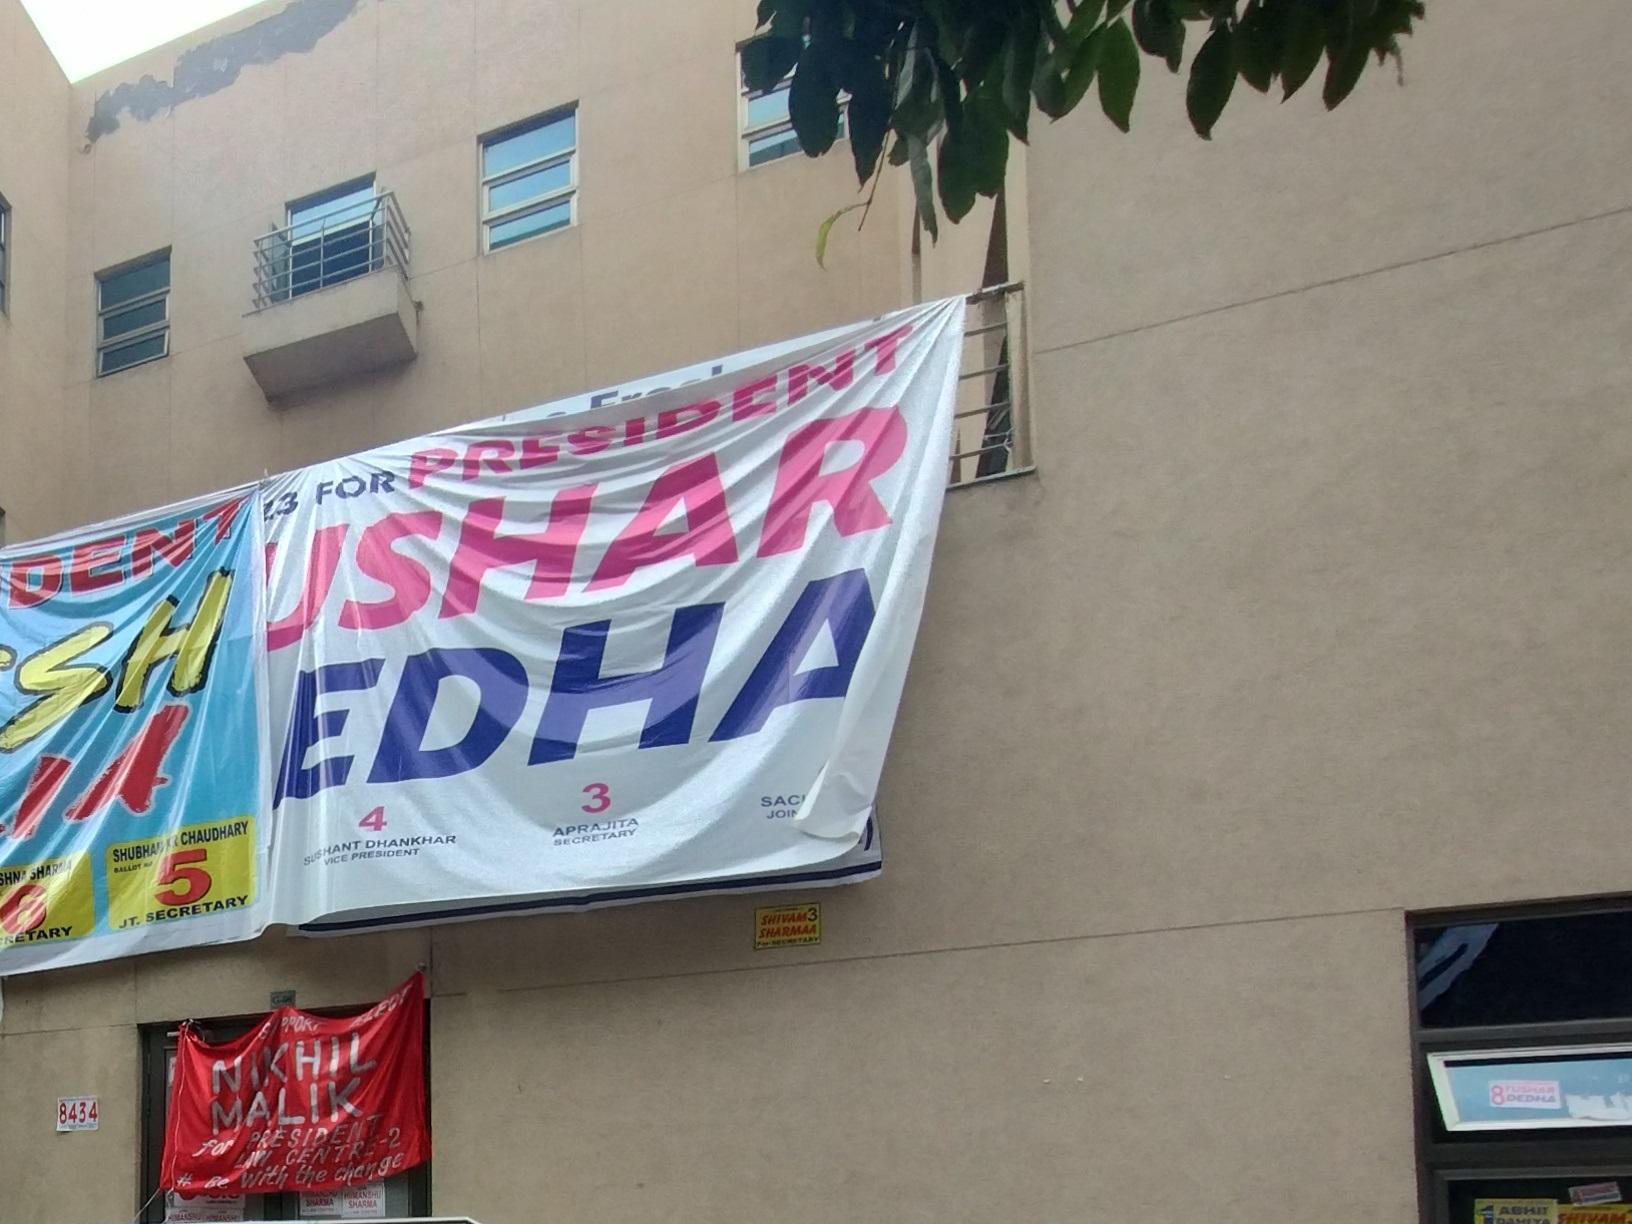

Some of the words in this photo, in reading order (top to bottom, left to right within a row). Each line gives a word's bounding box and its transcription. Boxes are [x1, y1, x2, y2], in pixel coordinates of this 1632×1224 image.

[316, 470, 396, 504] FOR
[407, 325, 916, 489] PRESIDENT
[581, 782, 611, 814] 3
[181, 820, 248, 846] CHAUDHARY
[358, 806, 388, 831] 4
[552, 817, 639, 838] APRAJITA
[303, 840, 362, 867] SUSHANT
[365, 834, 457, 850] DHANKHAR
[553, 828, 636, 846] SECRETARY
[323, 853, 349, 866] VICE
[351, 848, 420, 861] PRESIDENT
[154, 848, 212, 906] 5
[0, 883, 47, 935] 6
[119, 916, 141, 929] JT.
[146, 895, 248, 923] SECRETARY
[761, 913, 807, 926] SHIVAM
[808, 907, 818, 922] 3
[212, 1032, 377, 1094] NIKHIL
[212, 1077, 363, 1136] MALIK
[1491, 1085, 1505, 1105] 8
[1506, 1095, 1556, 1103] DEDHA
[58, 1102, 98, 1124] 8434
[193, 1140, 234, 1157] for
[247, 1114, 382, 1150] PRESIDENT
[295, 1164, 326, 1185] the
[334, 1152, 404, 1184] change
